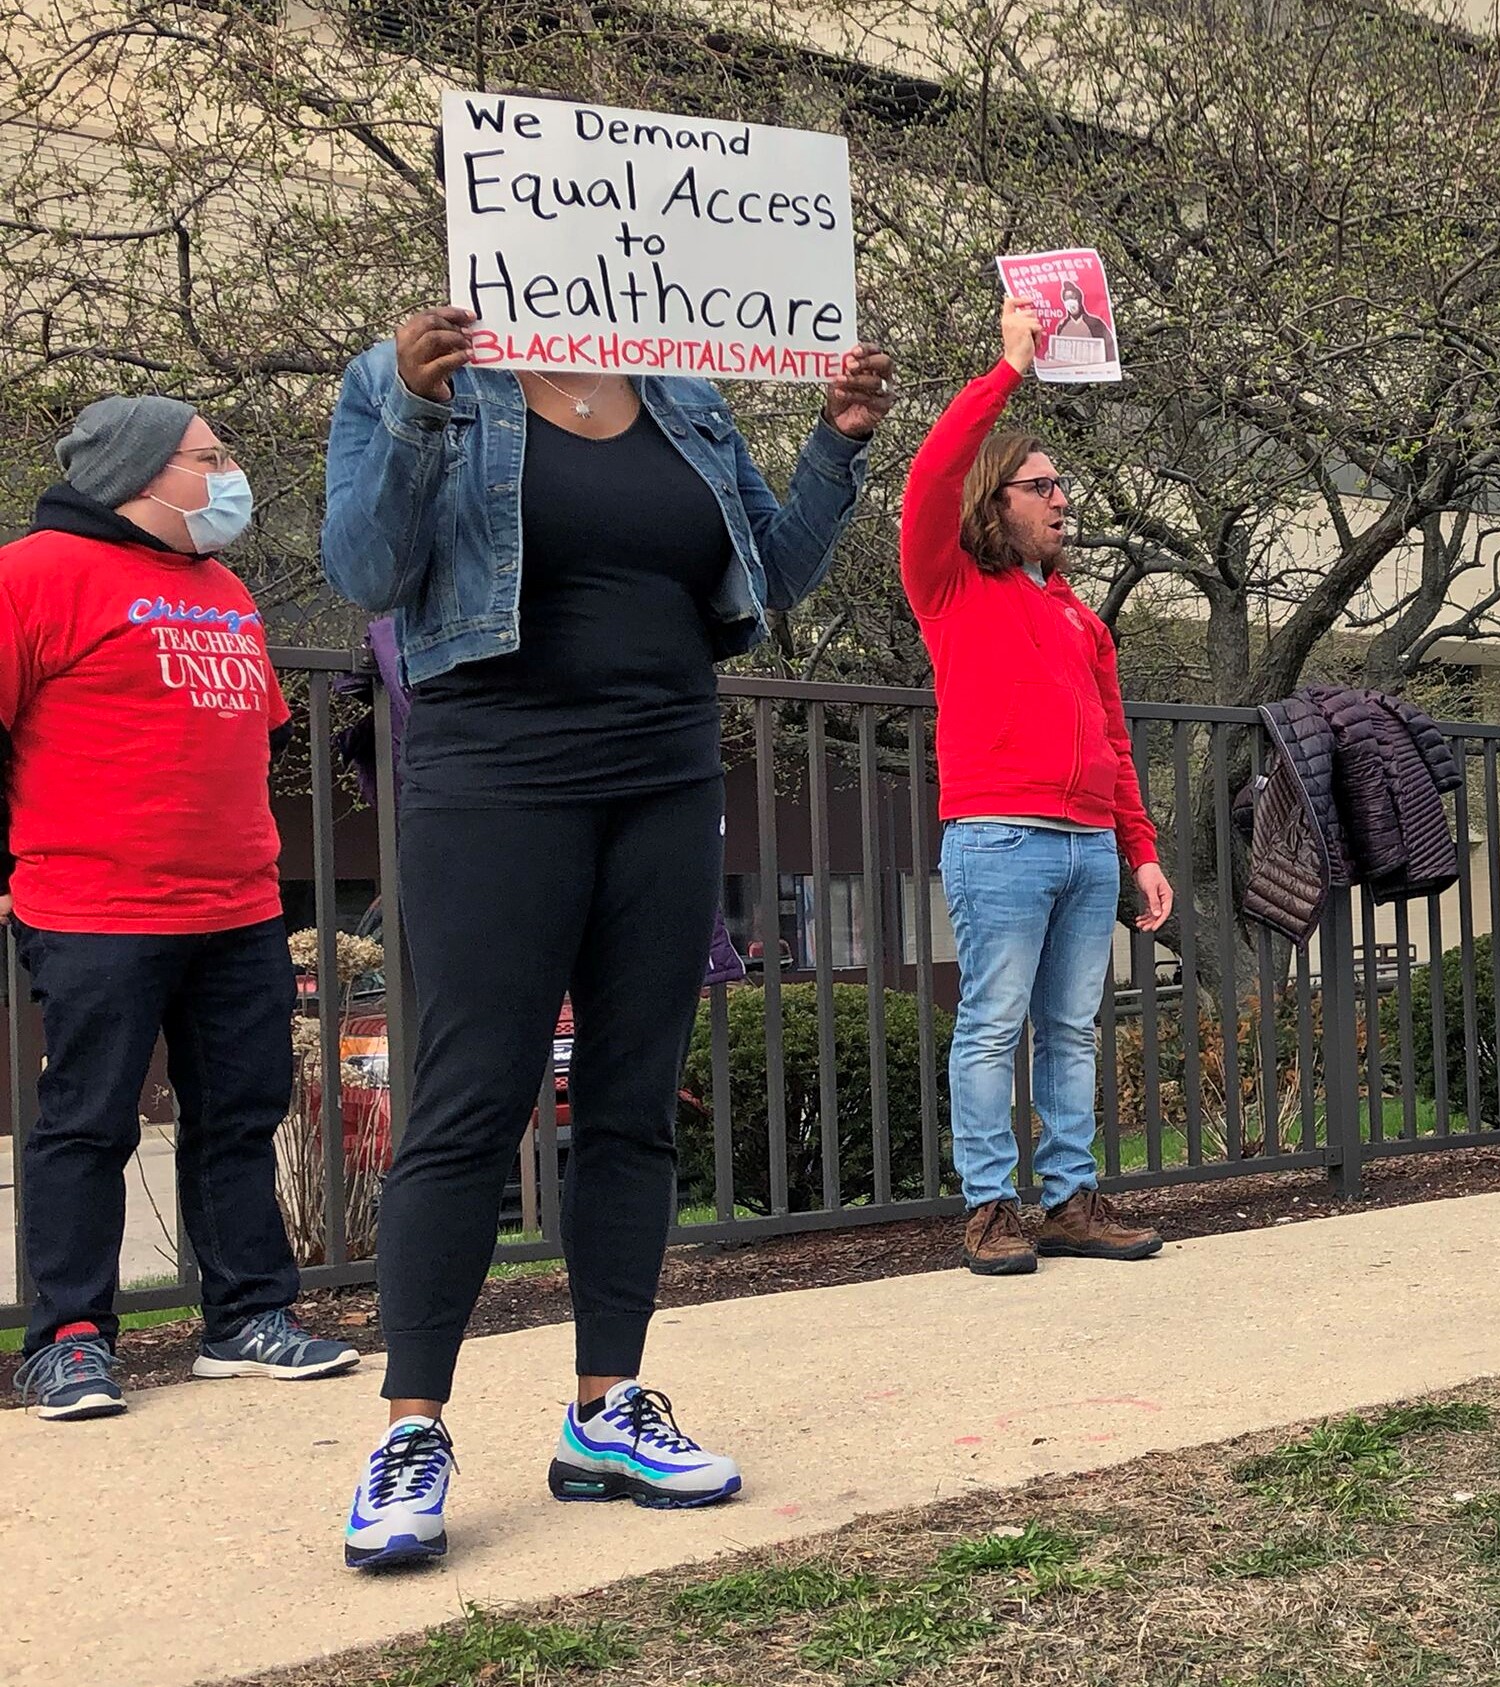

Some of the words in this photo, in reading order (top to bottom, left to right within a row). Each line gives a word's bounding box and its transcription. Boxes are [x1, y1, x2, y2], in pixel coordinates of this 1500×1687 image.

[466, 99, 542, 139] We
[575, 108, 751, 157] Demand
[463, 148, 637, 220] Equal
[661, 165, 836, 231] Access
[615, 221, 666, 257] to
[1008, 257, 1094, 279] #PROTECT
[1012, 270, 1080, 290] NURSES
[469, 250, 843, 342] Healthcare
[1038, 309, 1064, 318] PEND
[151, 627, 261, 656] TEACHERS
[156, 653, 267, 694] UNION
[190, 690, 252, 711] LOCAL
